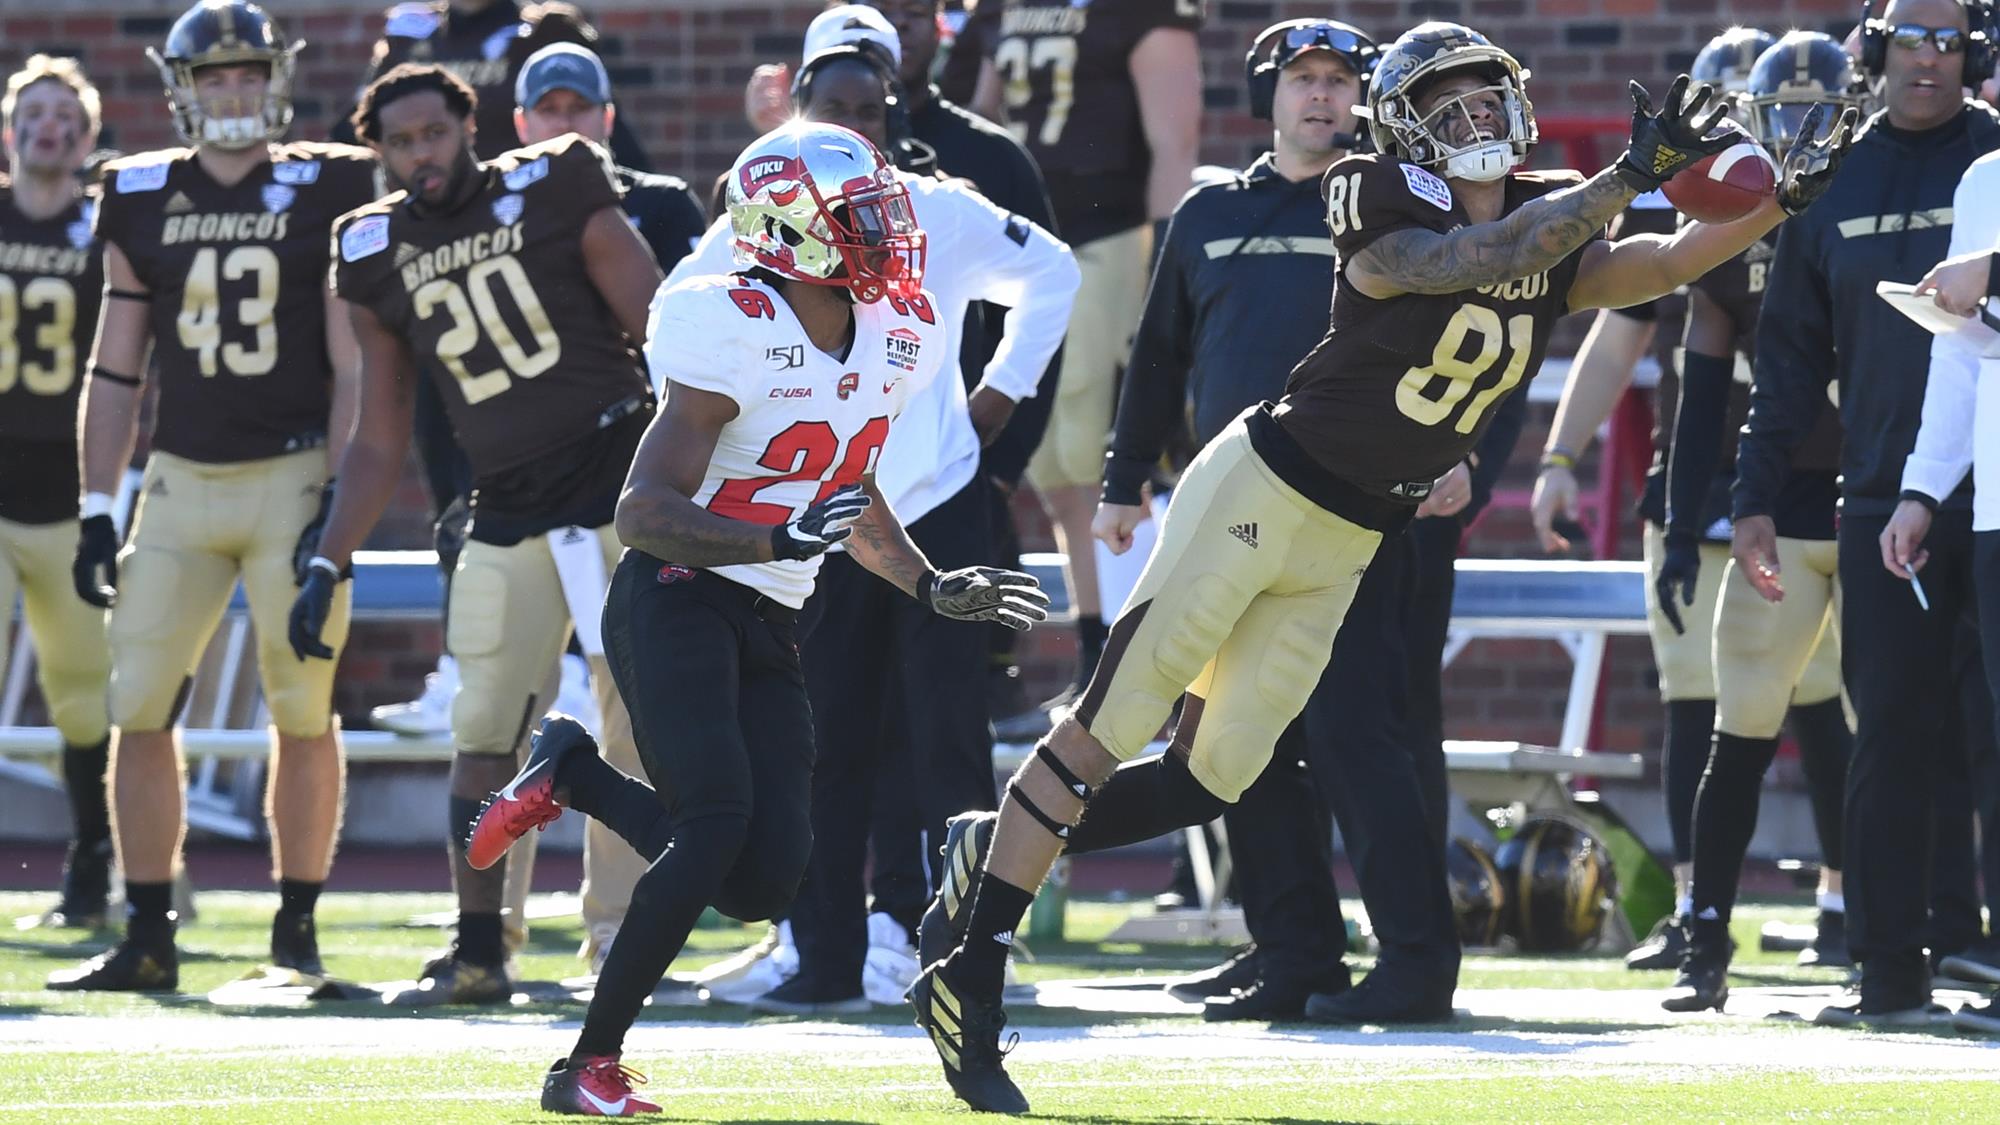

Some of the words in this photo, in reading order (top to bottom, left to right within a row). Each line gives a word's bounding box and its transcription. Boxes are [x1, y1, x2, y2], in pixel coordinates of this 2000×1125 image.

[749, 160, 784, 181] WKU
[161, 212, 291, 246] BRONCOS
[1328, 172, 1363, 237] 81
[0, 241, 89, 276] ONCOS
[401, 222, 524, 292] BRONCOS
[177, 246, 280, 378] 43
[413, 254, 561, 405] 20
[727, 277, 776, 321] 6
[1395, 303, 1534, 435] 81
